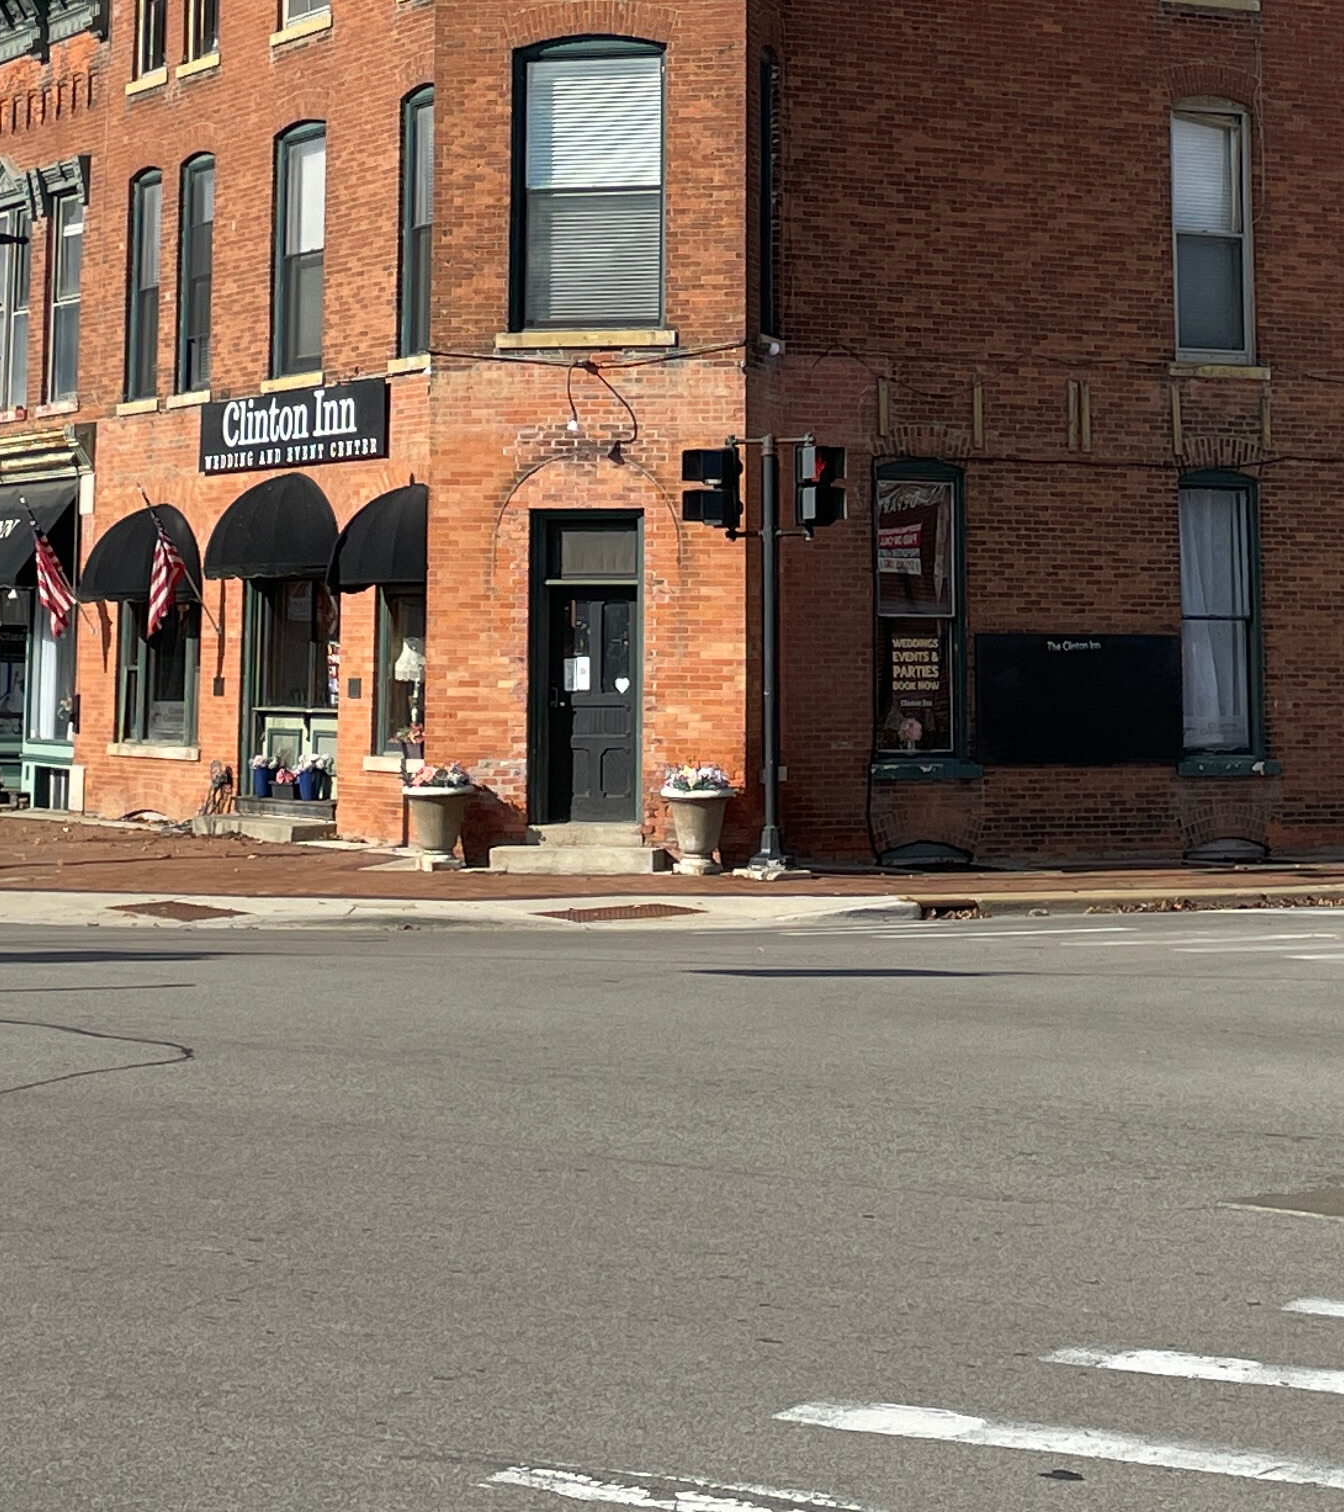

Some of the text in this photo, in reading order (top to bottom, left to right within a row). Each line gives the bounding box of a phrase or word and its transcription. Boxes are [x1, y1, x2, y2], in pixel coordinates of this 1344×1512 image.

[222, 389, 357, 447] Clinton Inn
[205, 438, 377, 470] WEDDING AND EVENT CENTER
[892, 638, 939, 648] WEDDINGS
[892, 651, 930, 663] EVENTS
[892, 665, 939, 679] PARTIES
